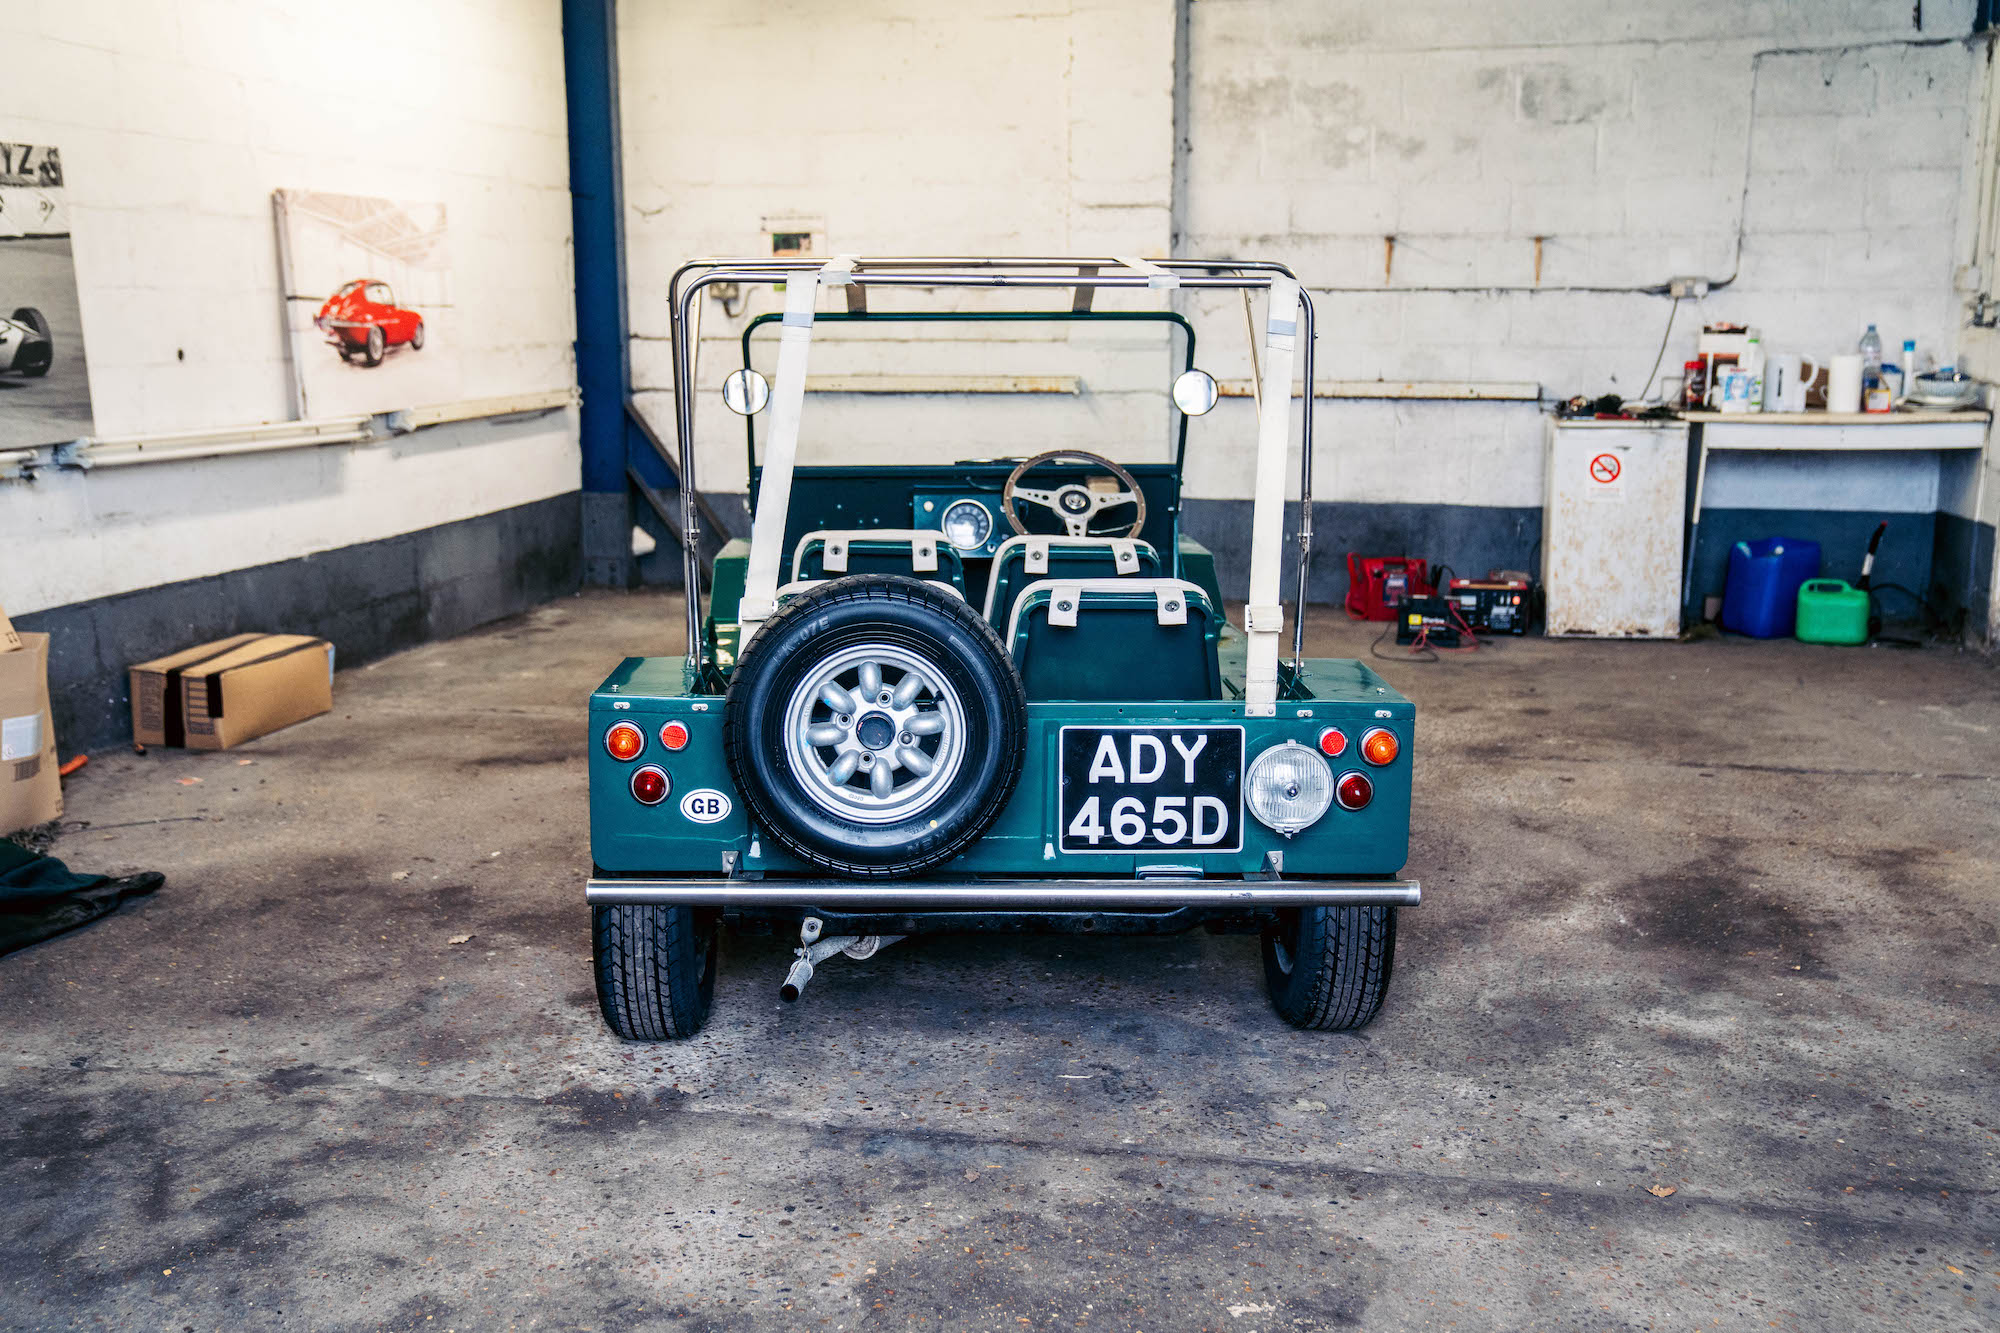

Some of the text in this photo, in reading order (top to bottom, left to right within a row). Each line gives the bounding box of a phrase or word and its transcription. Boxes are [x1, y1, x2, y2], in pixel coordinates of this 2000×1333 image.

[1089, 735, 1207, 783] ADY
[691, 798, 720, 814] GB
[1068, 796, 1229, 845] 465D
